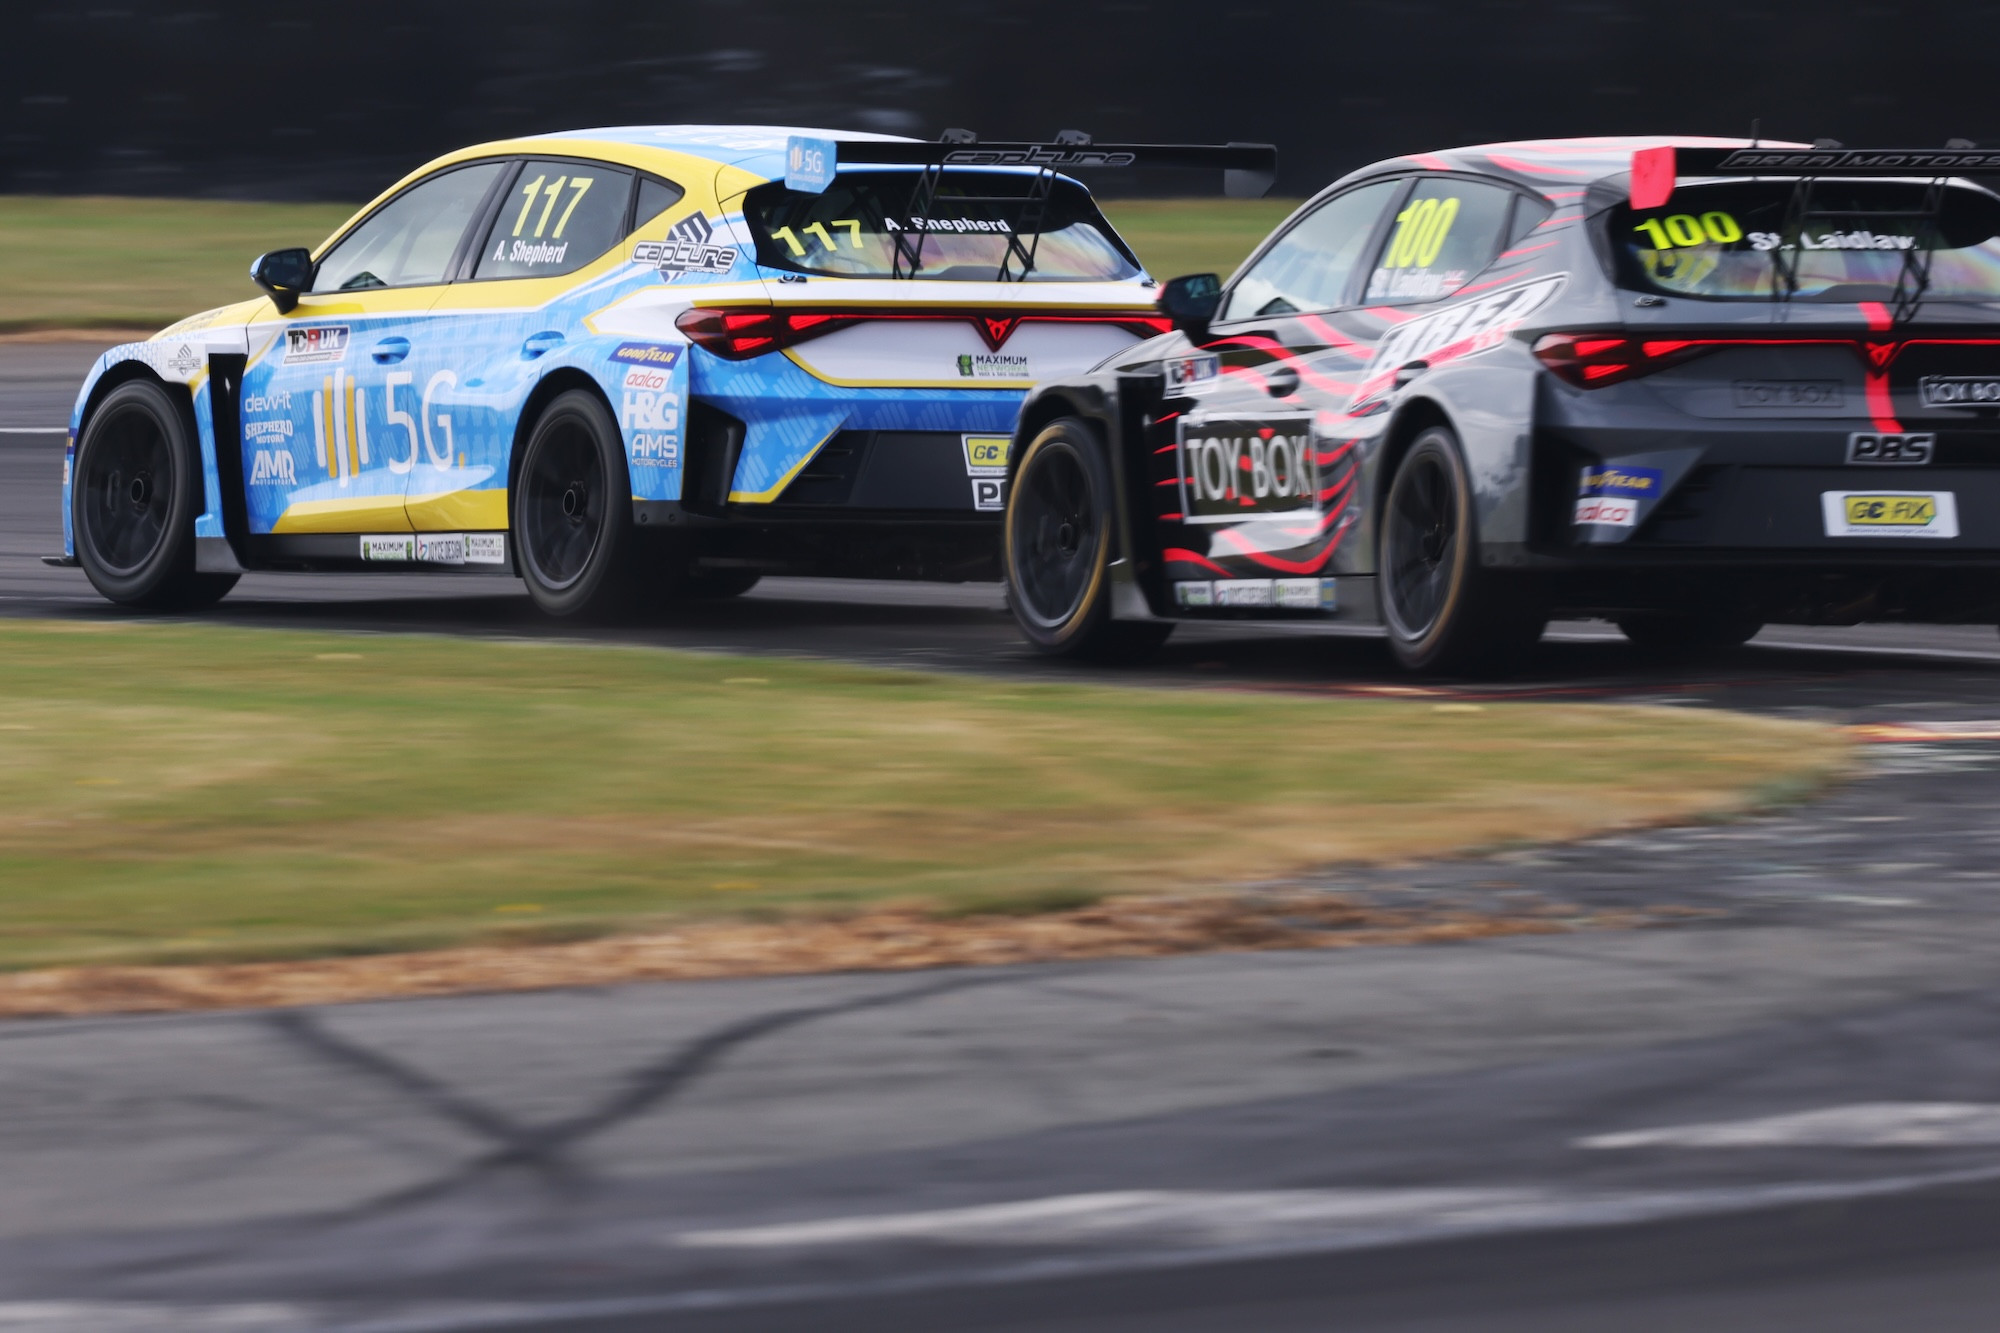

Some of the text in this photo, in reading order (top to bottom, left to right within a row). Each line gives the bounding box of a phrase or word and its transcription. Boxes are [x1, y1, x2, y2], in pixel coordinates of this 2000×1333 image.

[512, 175, 594, 239] 117
[771, 219, 864, 256] 117
[1384, 198, 1460, 268] 100
[1633, 211, 1743, 250] 100
[492, 240, 569, 267] A. Shepherd
[632, 235, 738, 269] capture
[287, 328, 341, 353] TCR UK
[617, 347, 675, 363] GOODYEAR
[976, 355, 1027, 365] MAXIMUM
[626, 371, 664, 389] aalco
[621, 391, 679, 430] H&G
[245, 420, 294, 440] SHEPHERD
[256, 434, 285, 444] MOTORS
[631, 433, 678, 459] AMS
[250, 449, 298, 485] AMR
[631, 458, 678, 468] MOTORCYCLES
[1186, 435, 1313, 501] TOY BOX
[372, 541, 404, 551] MAXIMUM
